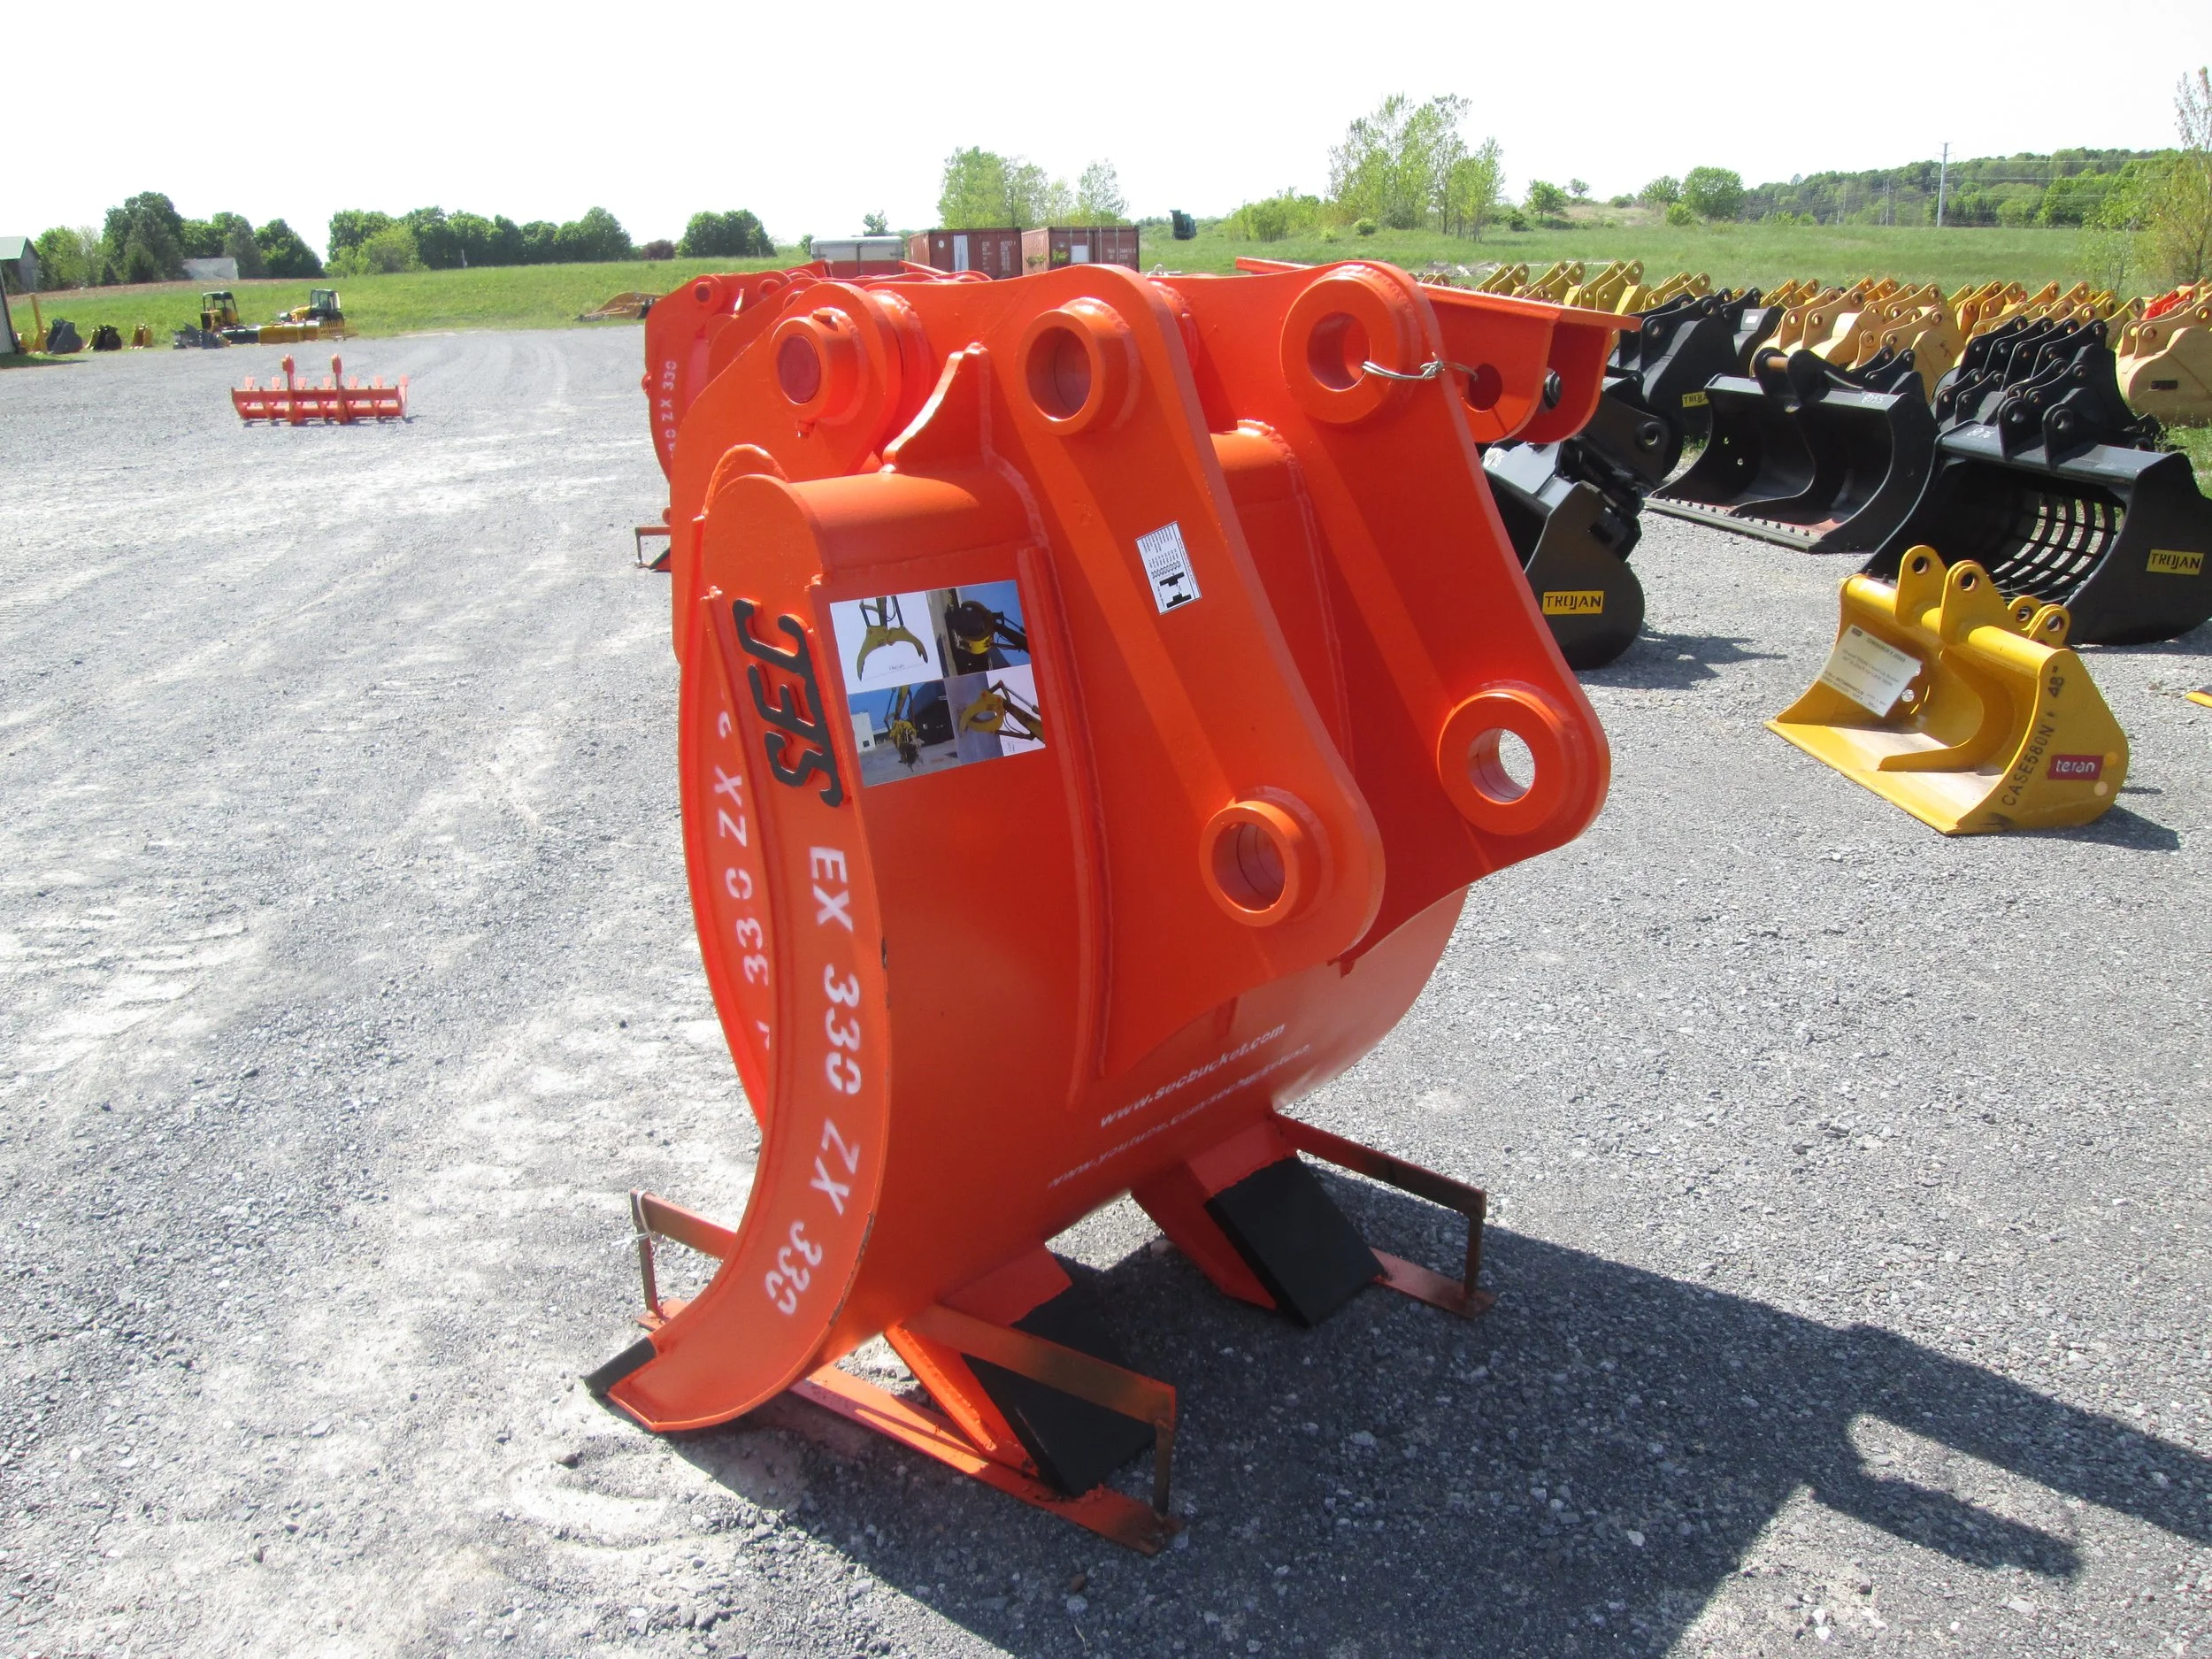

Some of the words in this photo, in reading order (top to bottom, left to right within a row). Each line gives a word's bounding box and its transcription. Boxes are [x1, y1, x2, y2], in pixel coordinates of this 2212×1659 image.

[660, 399, 674, 422] ZX
[662, 360, 677, 391] 330
[1545, 595, 1601, 611] TROJAN
[2151, 553, 2201, 570] TROJAN
[732, 597, 847, 808] SEC
[713, 764, 748, 847] ZX
[2055, 758, 2095, 773] teran
[725, 866, 770, 987] 330
[809, 846, 854, 933] EX
[823, 963, 862, 1095] 330
[1100, 1023, 1286, 1128] www.secbucket.com
[810, 1118, 860, 1217] ZX
[764, 1220, 823, 1316] 330
